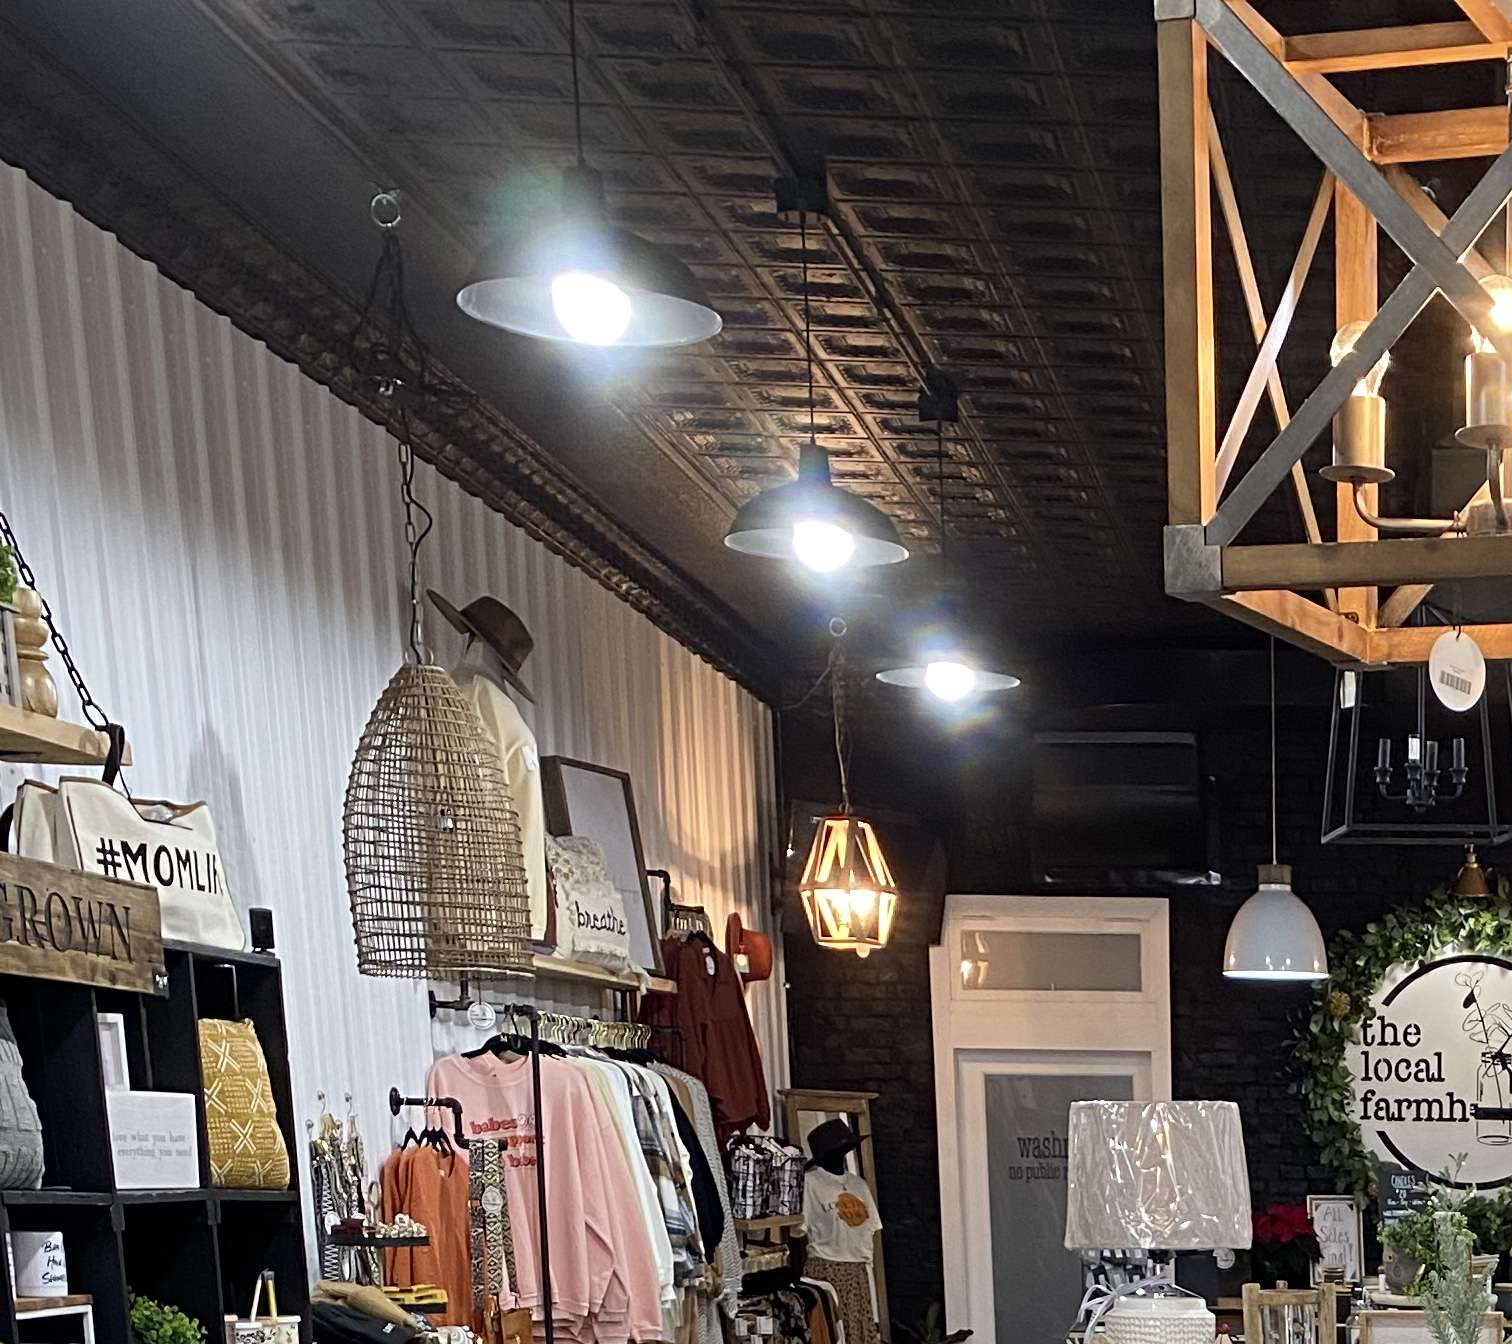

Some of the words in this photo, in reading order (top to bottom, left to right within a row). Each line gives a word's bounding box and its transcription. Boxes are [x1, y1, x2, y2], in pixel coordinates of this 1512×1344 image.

[575, 900, 626, 936] breathe
[1360, 1015, 1422, 1047] the
[1360, 1050, 1446, 1083] local
[1017, 1131, 1069, 1160] washr
